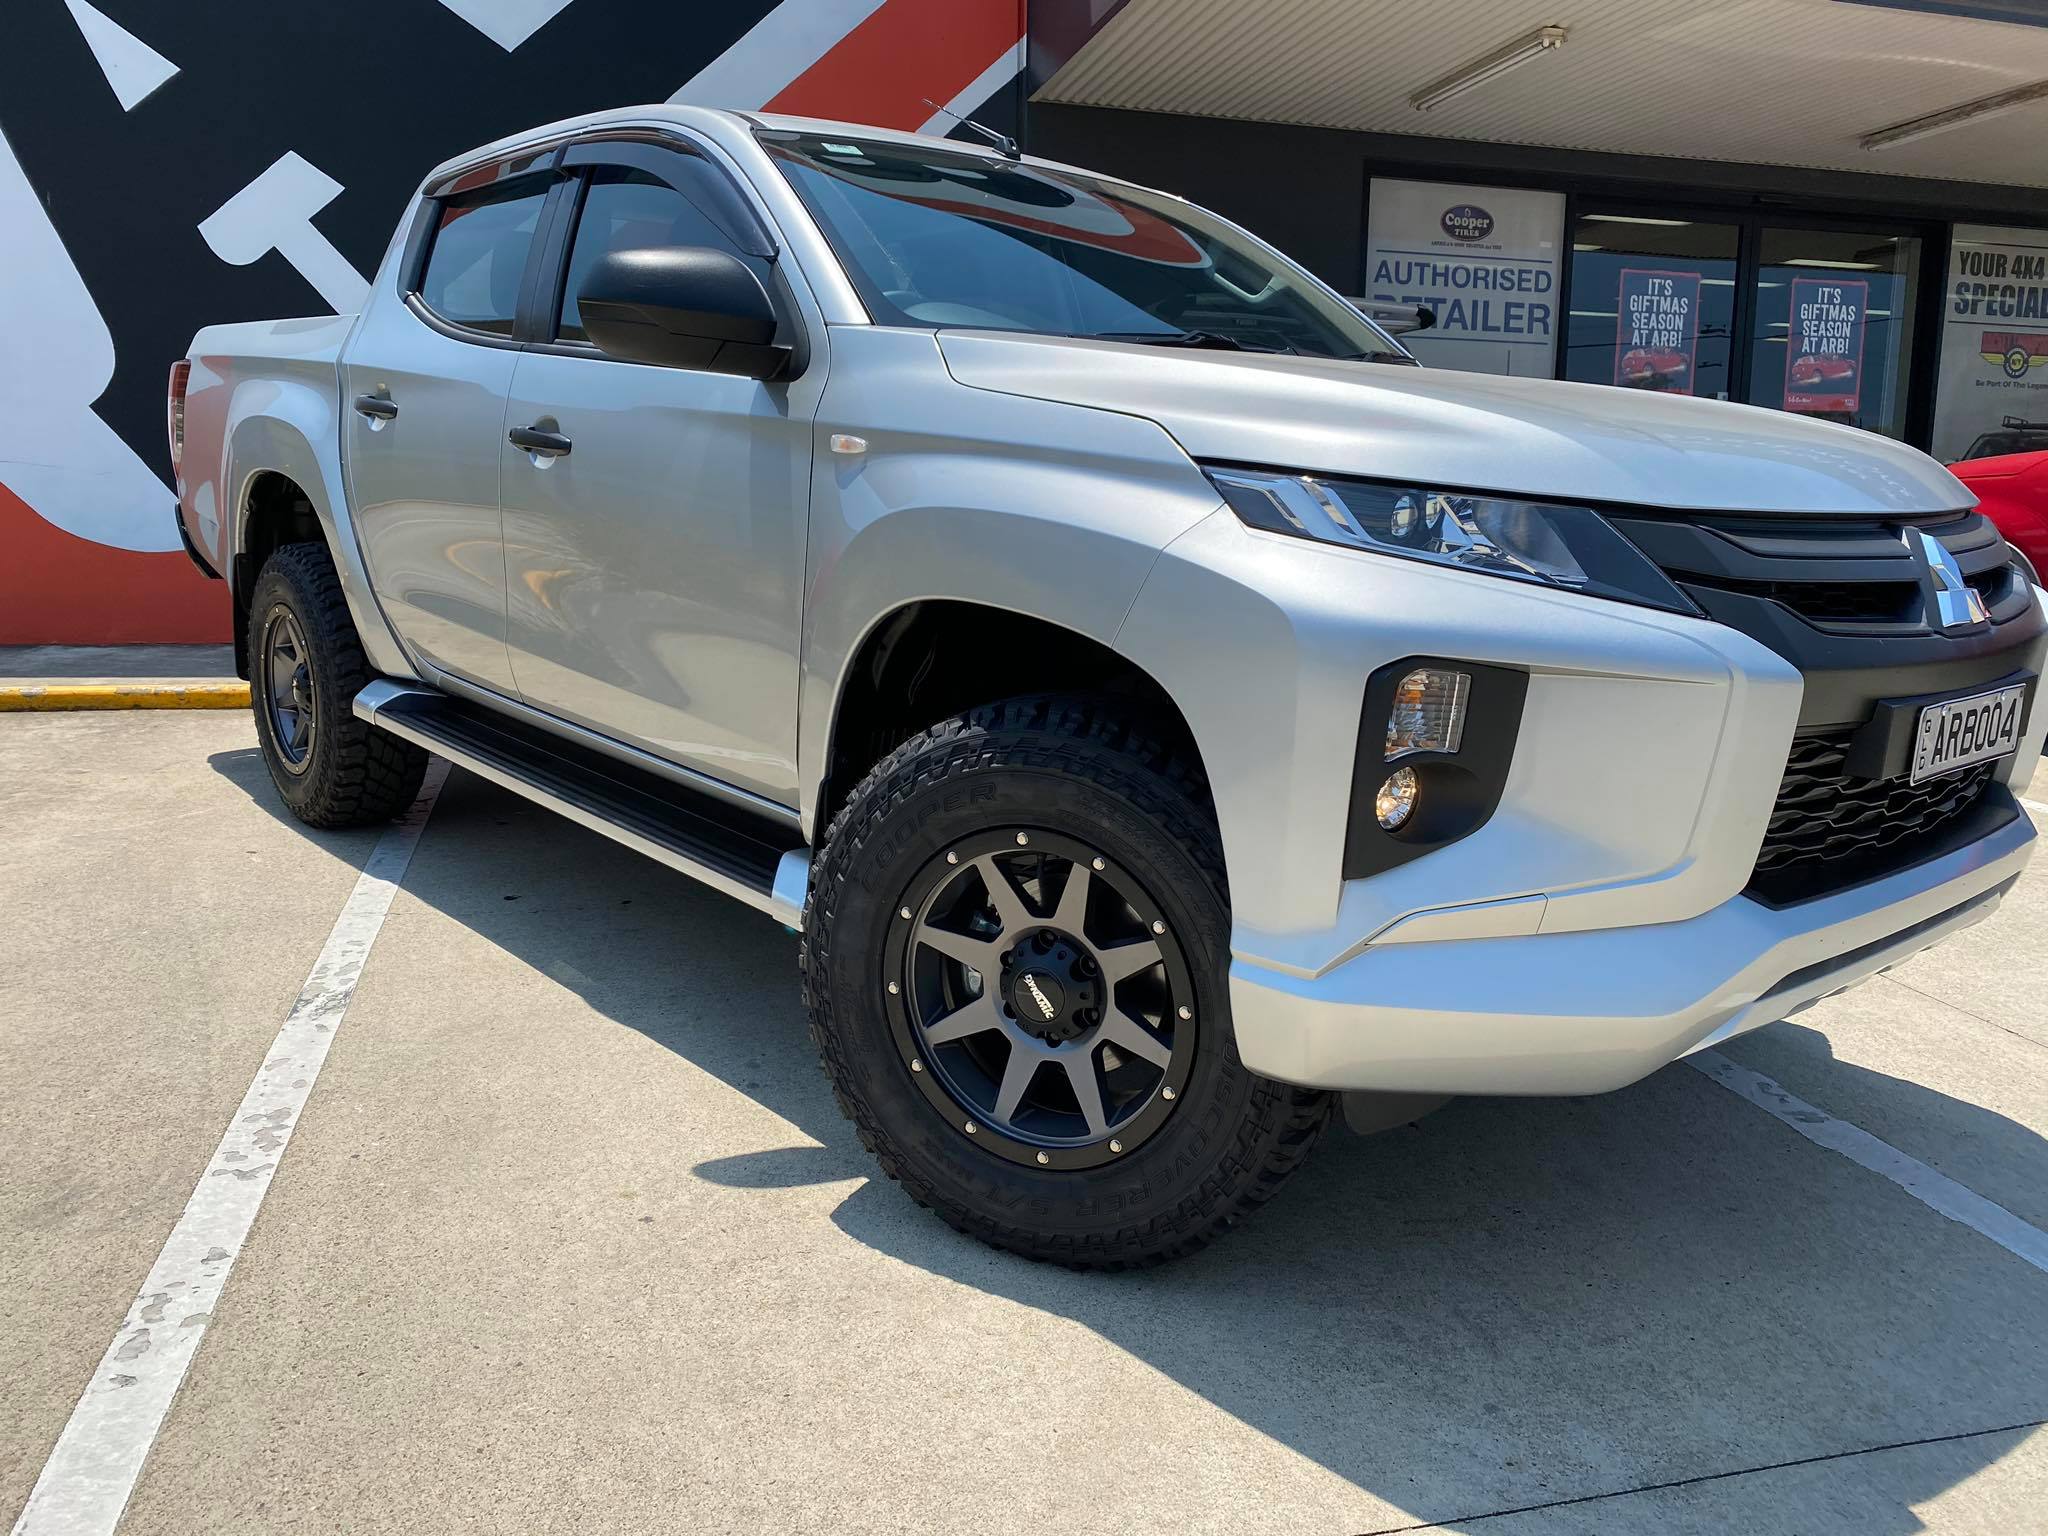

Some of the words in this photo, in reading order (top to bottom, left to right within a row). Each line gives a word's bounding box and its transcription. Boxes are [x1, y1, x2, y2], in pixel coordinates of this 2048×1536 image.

[1445, 213, 1489, 229] Cooper
[1455, 228, 1480, 236] TIRES
[1960, 251, 2007, 277] YOUR
[1374, 260, 1552, 293] AUTHORISED
[1648, 279, 1673, 296] IT'S
[1818, 287, 1841, 304] IT'S
[1630, 295, 1688, 314] GIFTMAS
[1800, 304, 1856, 321] GIFTMAS
[1374, 294, 1550, 335] TAILER
[1632, 313, 1683, 331] SEASON
[1802, 321, 1851, 338] SEASON
[1631, 331, 1649, 346] AT
[1651, 332, 1682, 348] ARB!
[1801, 338, 1818, 353] AT
[1820, 338, 1849, 354] ARB!
[1931, 698, 2017, 765] ARB004
[862, 782, 996, 893] COOPER
[1024, 974, 1054, 1019] DYNAMIC
